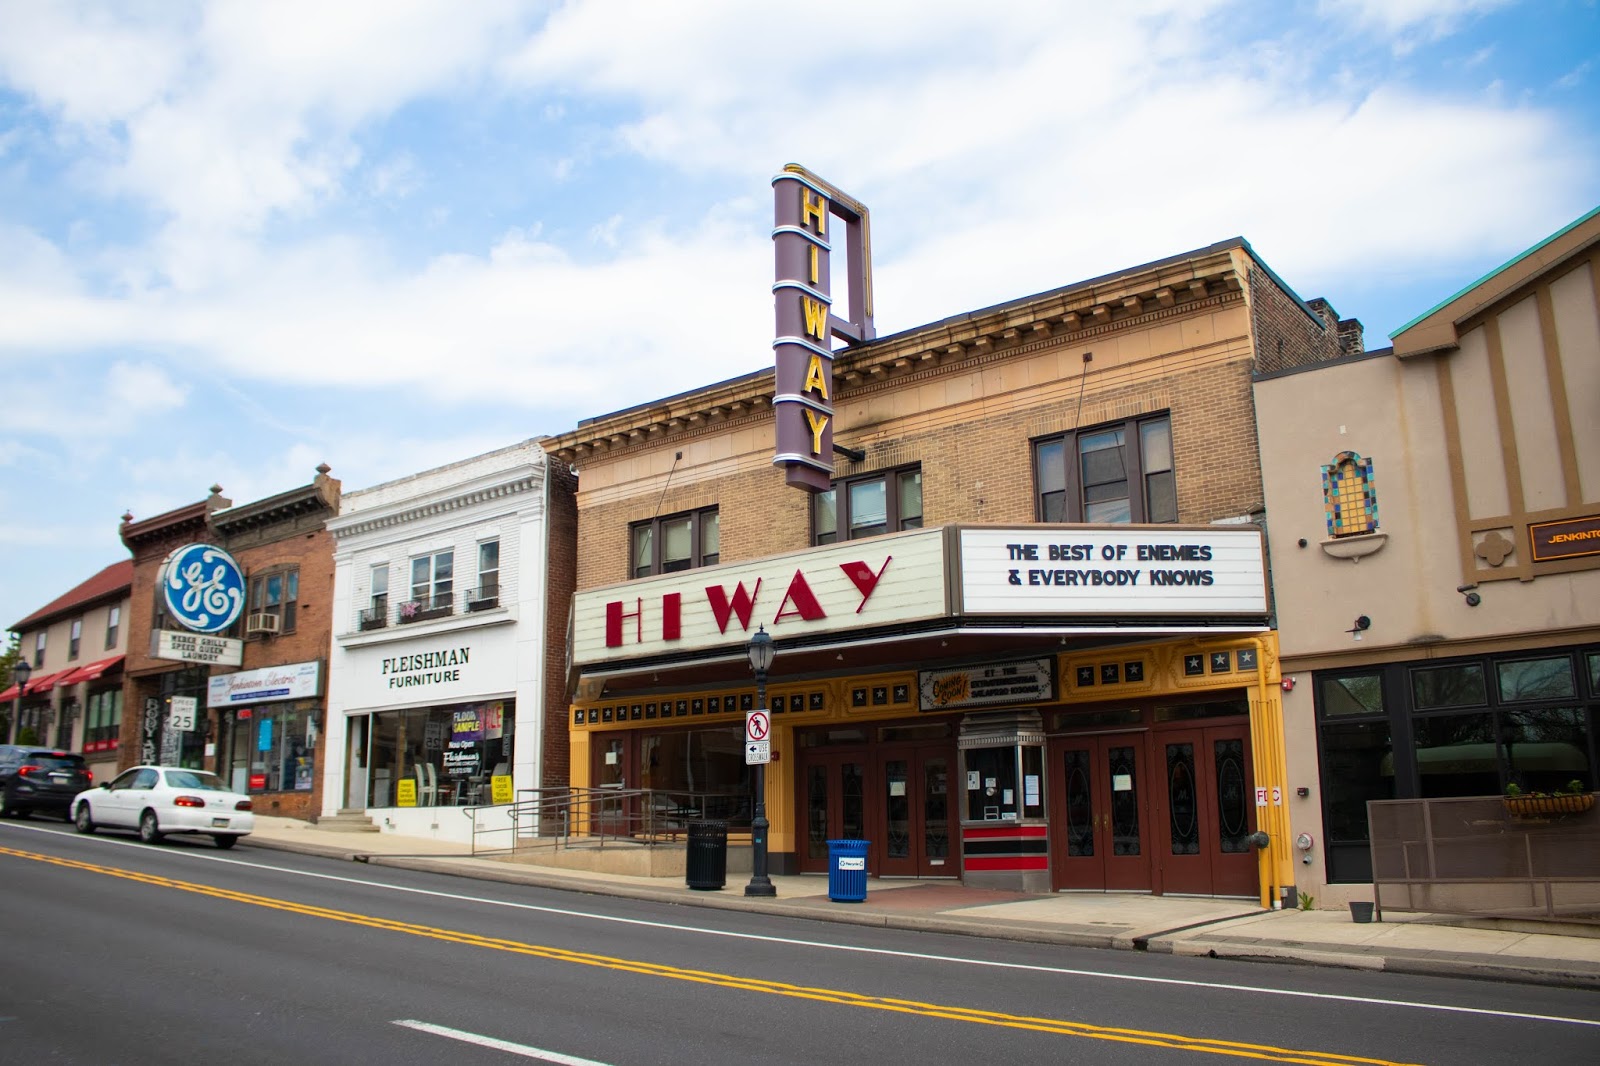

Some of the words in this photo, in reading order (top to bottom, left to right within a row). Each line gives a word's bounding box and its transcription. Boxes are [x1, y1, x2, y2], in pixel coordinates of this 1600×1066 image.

[799, 186, 829, 456] HIWAY
[1006, 544, 1038, 561] THE
[1048, 544, 1094, 561] BEST
[1102, 544, 1128, 561] OF
[1137, 544, 1212, 562] ENEMIES
[1008, 569, 1021, 586] &
[1028, 569, 1140, 586] EVERYBODY
[1150, 569, 1214, 586] KNOWS
[605, 555, 892, 648] HIWAY
[171, 635, 196, 644] WEBER
[201, 638, 227, 648] GRILLS
[171, 642, 195, 652] SPEED
[199, 645, 223, 655] QUEEN
[182, 651, 218, 661] LAUNDRY
[382, 647, 470, 674] FLEISHMAN
[265, 671, 296, 686] Electric
[389, 670, 460, 689] FURNITURE
[933, 676, 961, 697] COMING
[173, 715, 191, 728] 25
[454, 710, 476, 722] FLOOR
[454, 721, 480, 733] SAMPLE
[759, 743, 768, 752] USE
